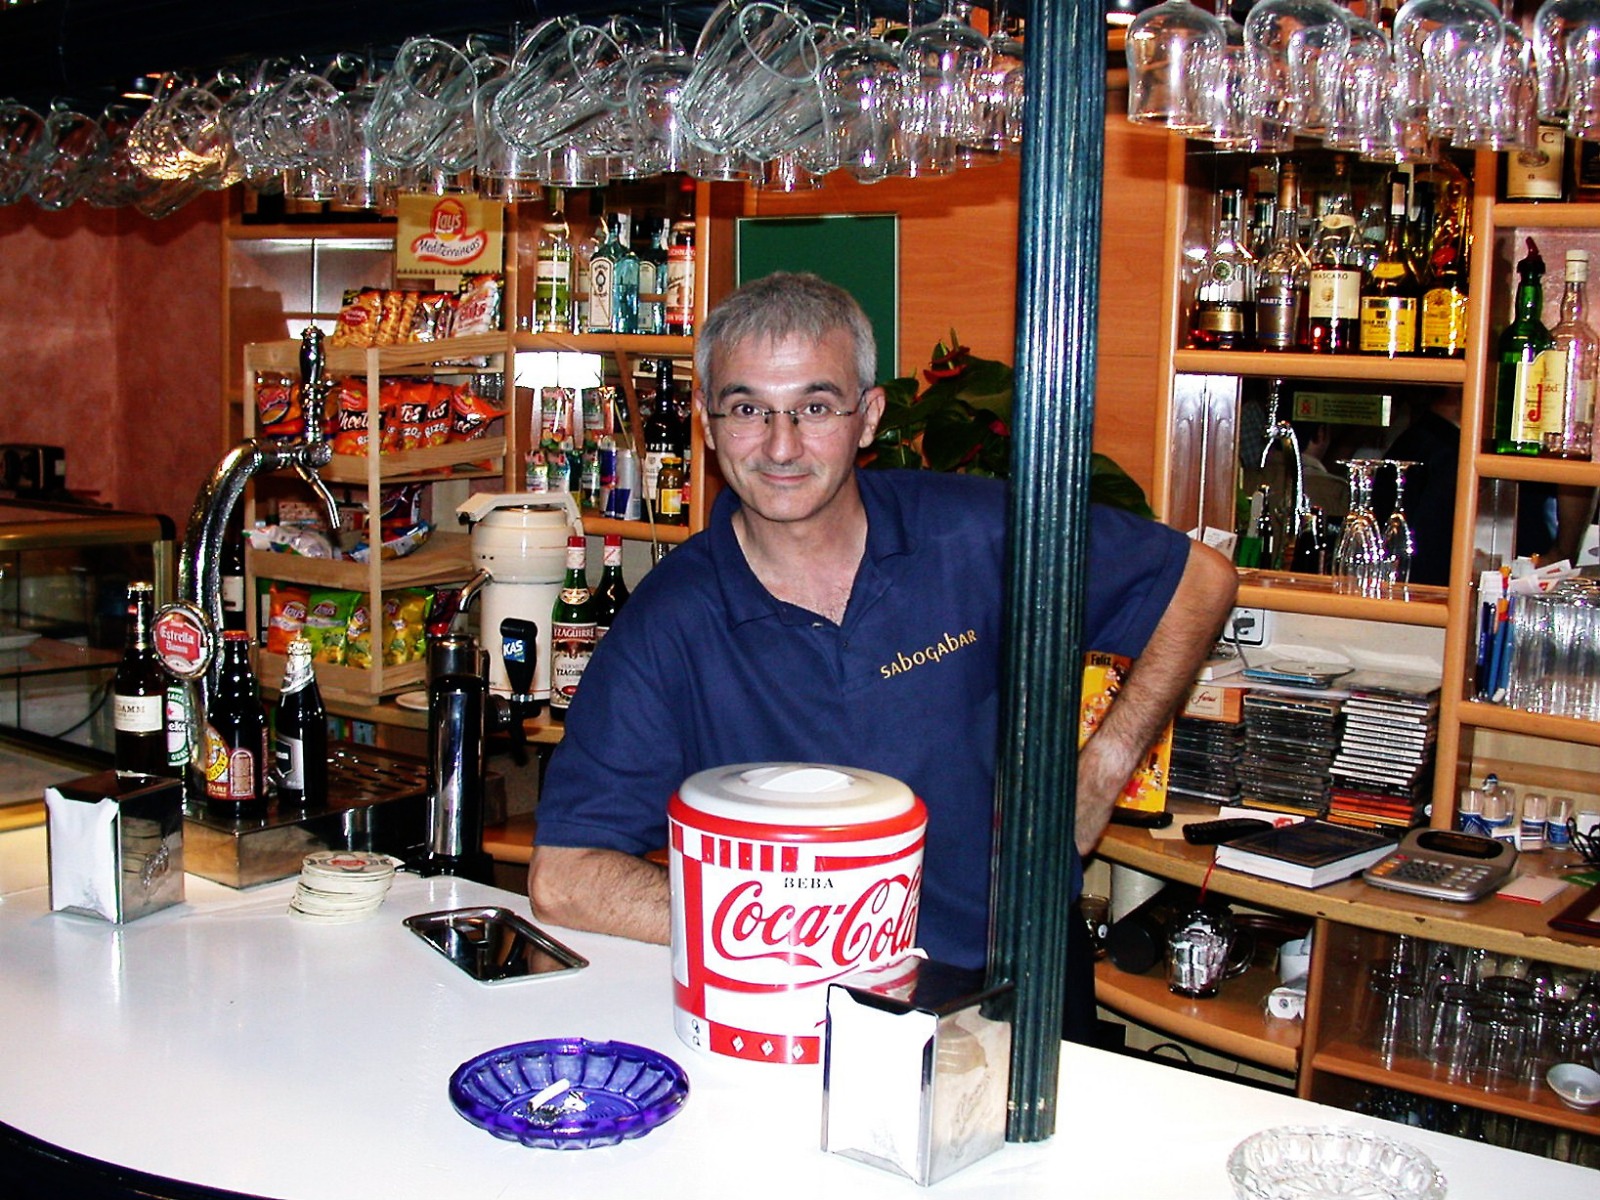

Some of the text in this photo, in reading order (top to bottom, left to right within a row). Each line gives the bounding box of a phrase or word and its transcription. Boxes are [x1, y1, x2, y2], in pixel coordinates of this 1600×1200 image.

[159, 624, 196, 645] Estrella
[502, 638, 524, 657] KAS
[784, 876, 834, 890] BEBA
[711, 864, 922, 968] Coca-Cola
